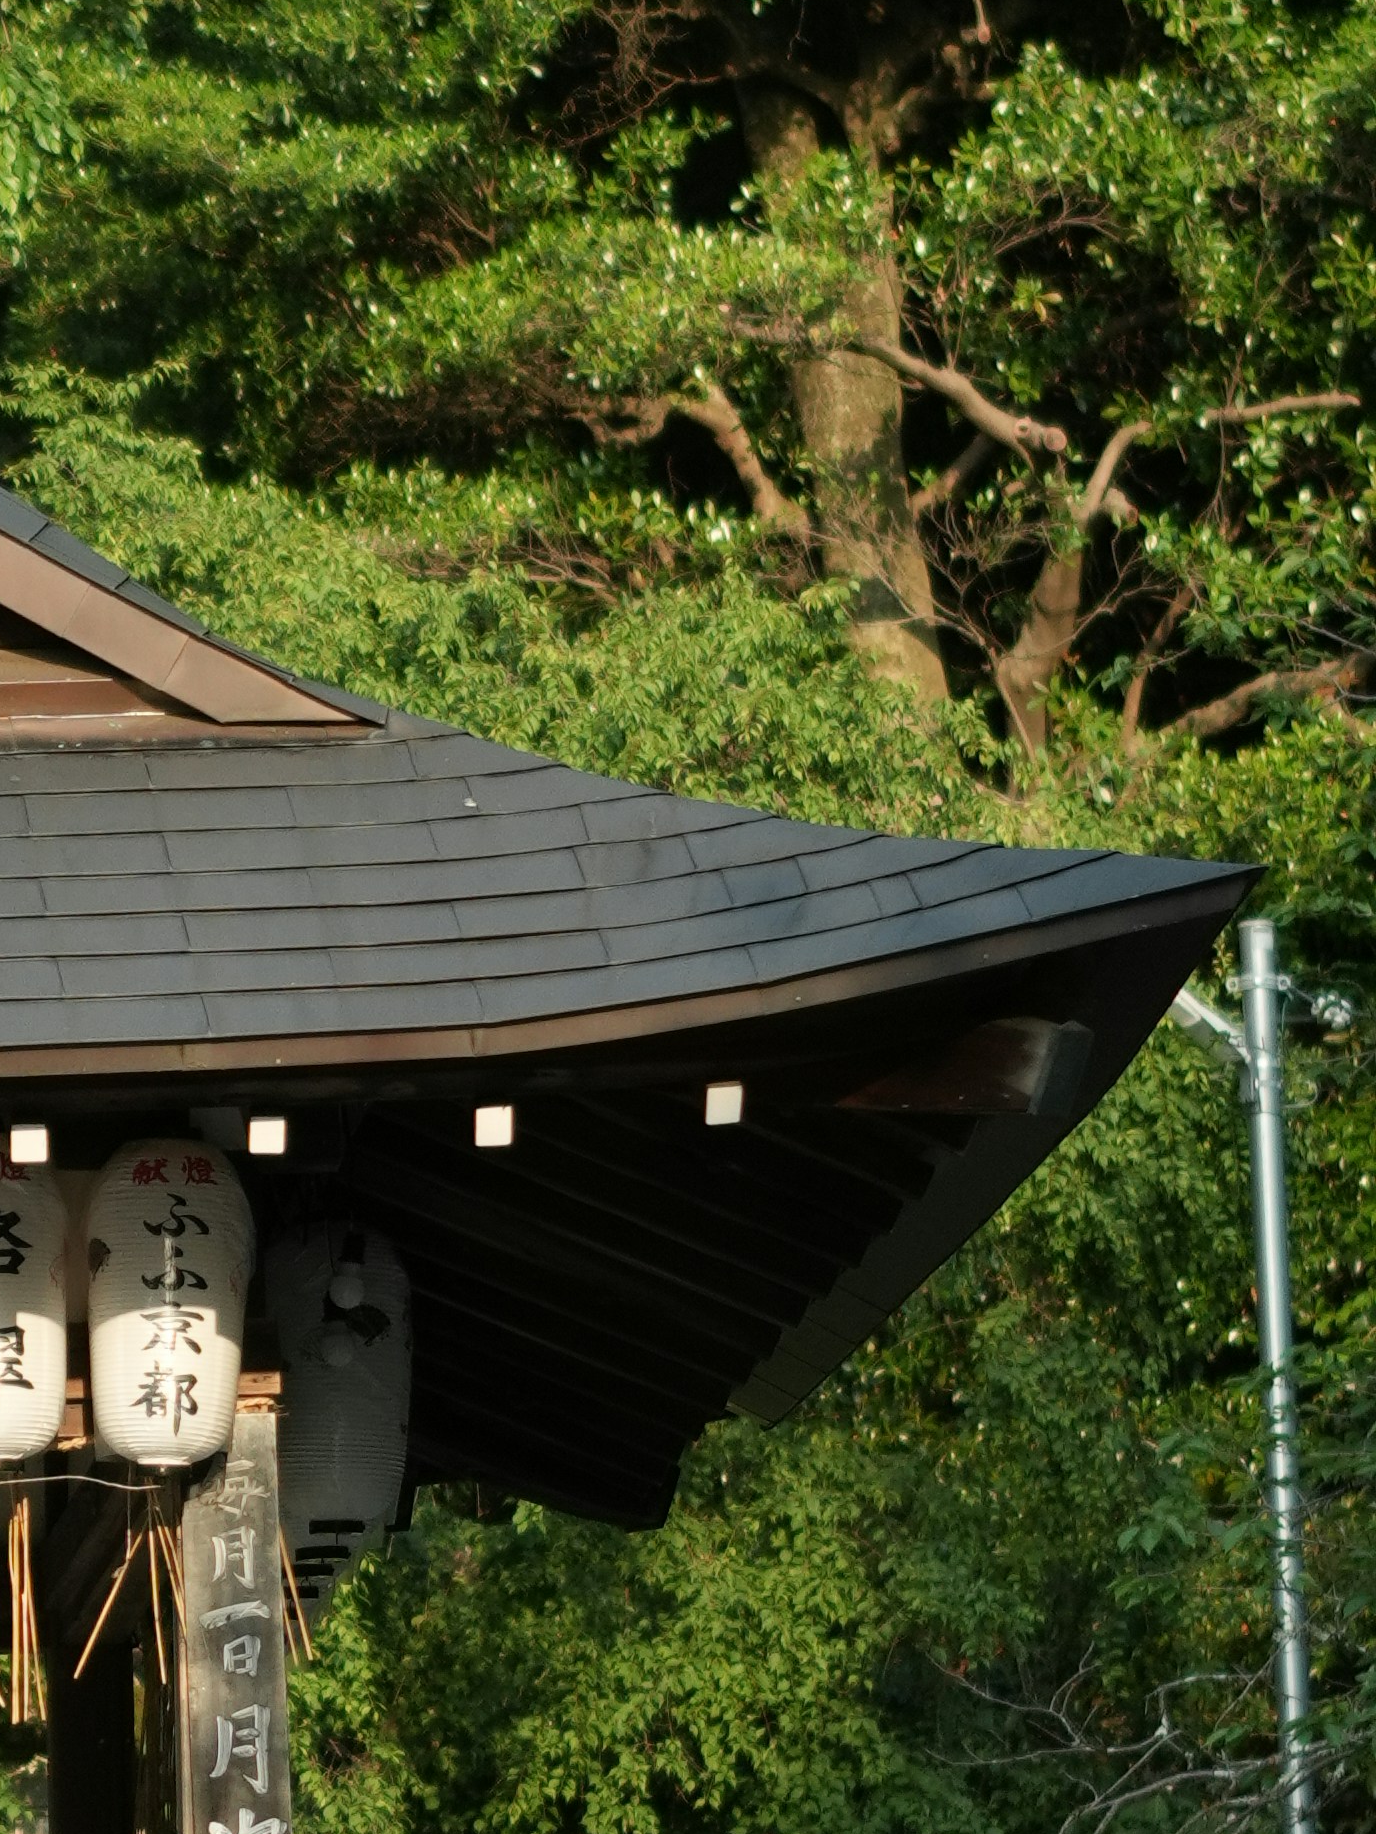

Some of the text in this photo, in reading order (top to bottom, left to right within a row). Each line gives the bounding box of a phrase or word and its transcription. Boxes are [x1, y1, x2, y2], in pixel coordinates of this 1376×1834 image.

[132, 1156, 218, 1186] 献燈
[128, 1193, 210, 1437] ふふ京都
